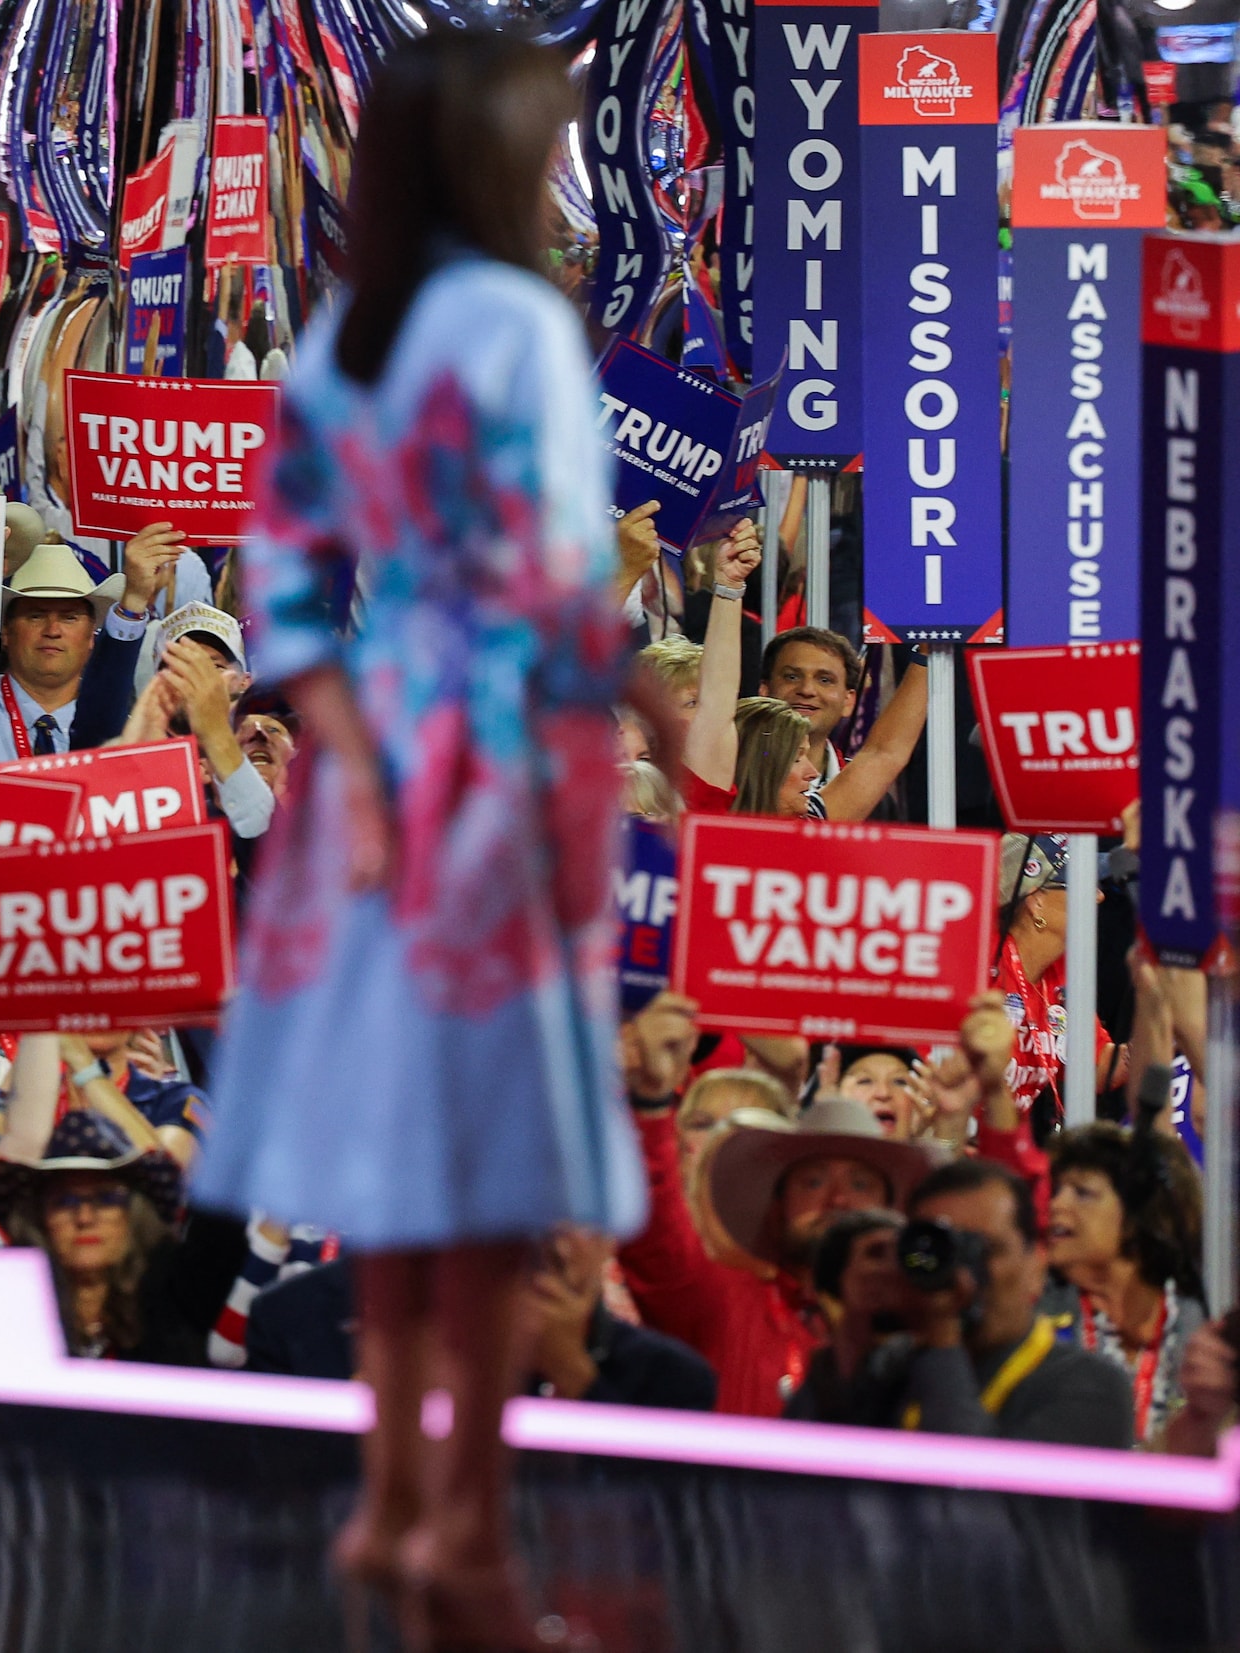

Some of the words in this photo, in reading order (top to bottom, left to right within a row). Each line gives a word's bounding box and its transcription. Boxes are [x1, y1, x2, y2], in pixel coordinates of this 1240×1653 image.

[884, 86, 973, 98] MILWAUKEE
[1041, 184, 1140, 199] MILWAUKEE
[782, 24, 852, 431] WYOMING
[901, 146, 958, 604] MISSOURI
[79, 413, 266, 459] TRUMP
[596, 392, 722, 483] TRUMP
[1066, 244, 1107, 638] MASSACHUSE
[97, 455, 243, 493] VANCE
[613, 449, 653, 474] AMERICA
[653, 467, 678, 487] GREAT
[91, 492, 117, 505] MAKE
[118, 494, 166, 509] AMERICA
[167, 498, 208, 511] GREAT
[1162, 367, 1198, 920] NEBRASKA
[1000, 707, 1135, 756] TRU
[702, 864, 973, 932] TRUMP
[728, 921, 941, 977] VANCE
